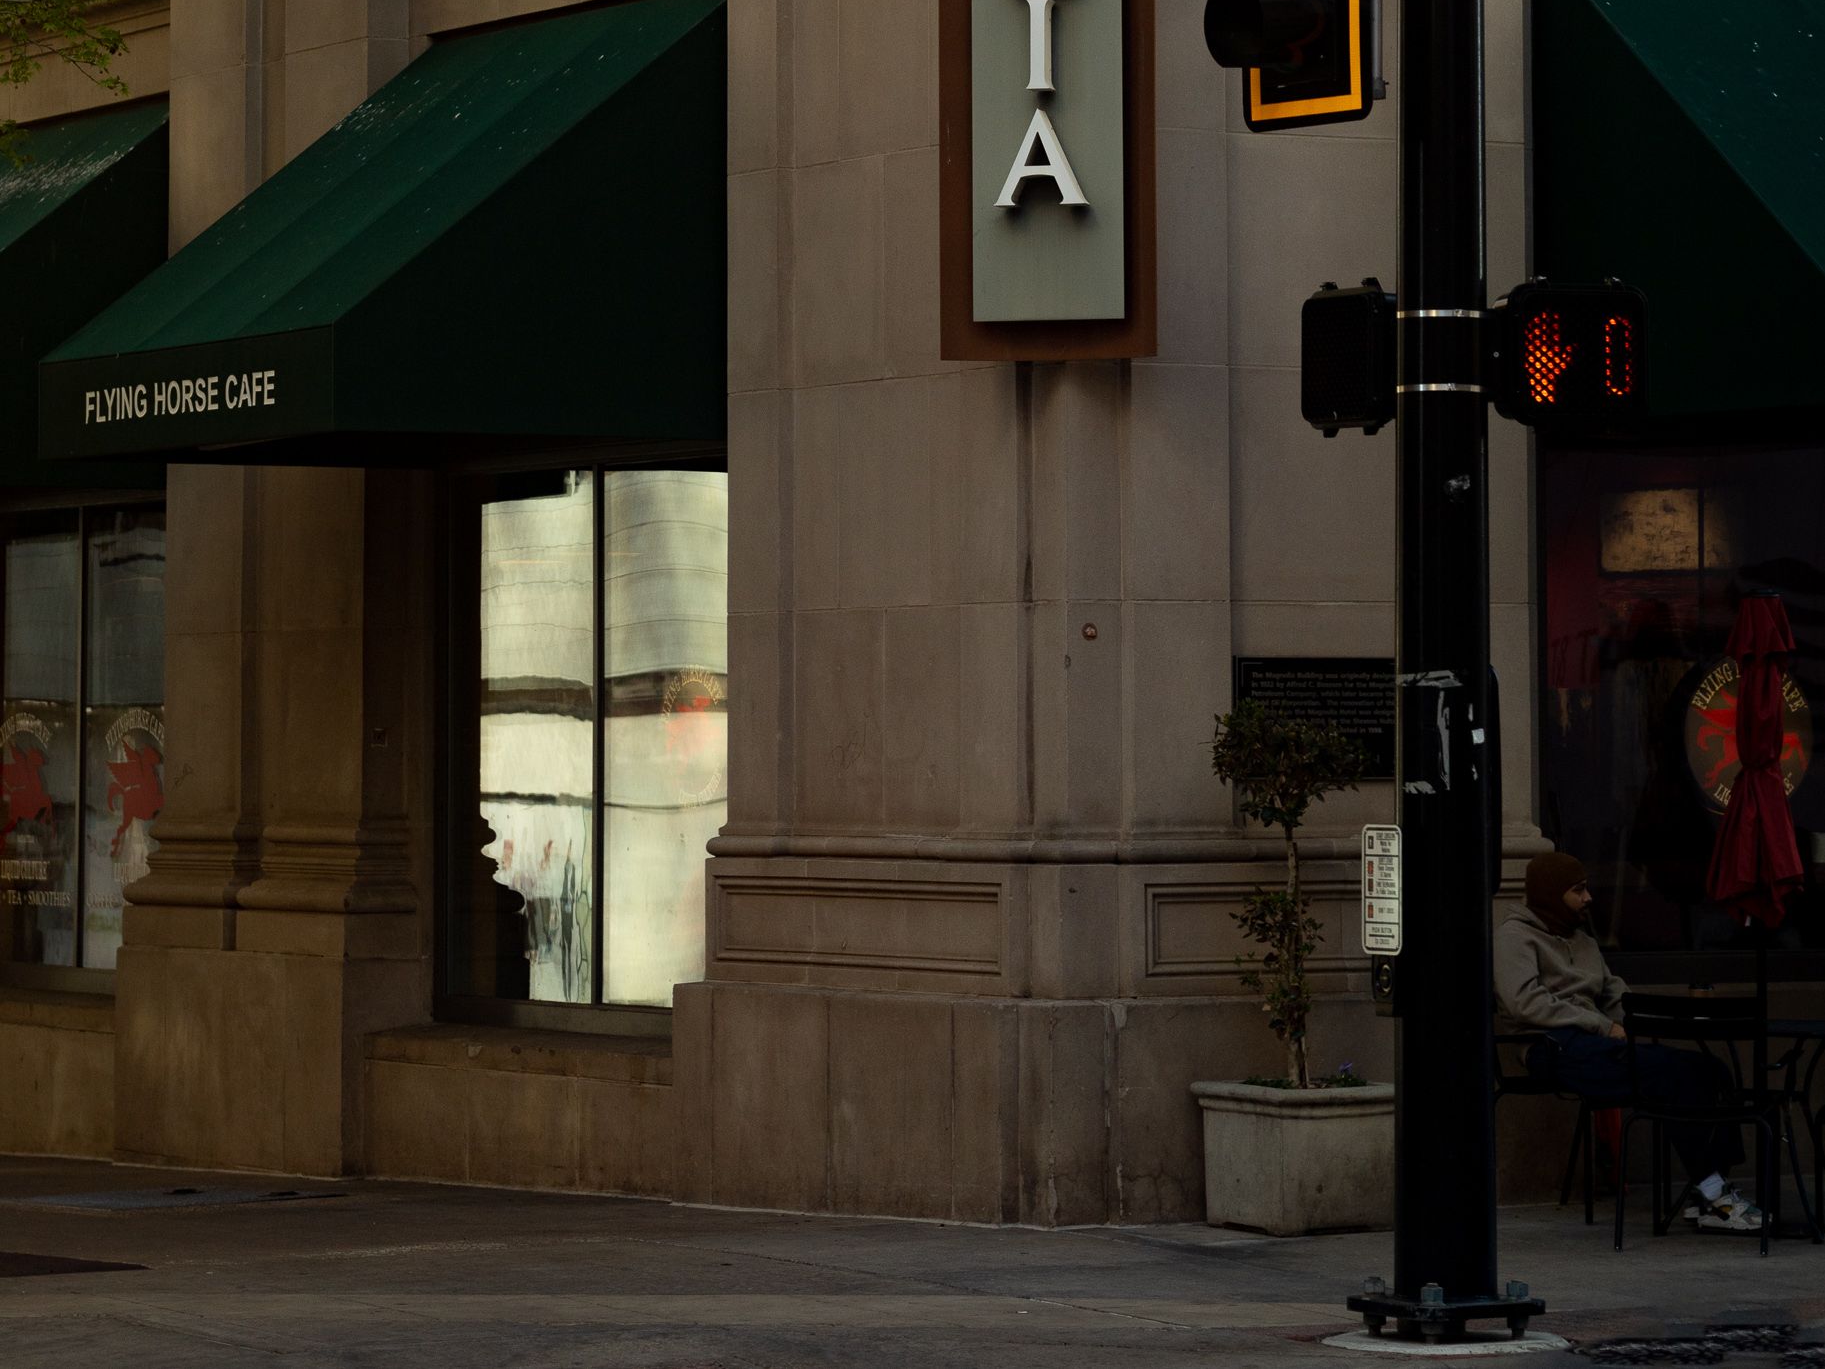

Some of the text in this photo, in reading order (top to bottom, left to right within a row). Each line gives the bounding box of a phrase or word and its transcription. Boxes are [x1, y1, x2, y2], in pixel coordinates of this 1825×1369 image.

[85, 370, 275, 425] FLYING HORSE CAFE
[1692, 663, 1733, 710] FLYING
[149, 715, 164, 747] CAF
[7, 889, 22, 906] TEA
